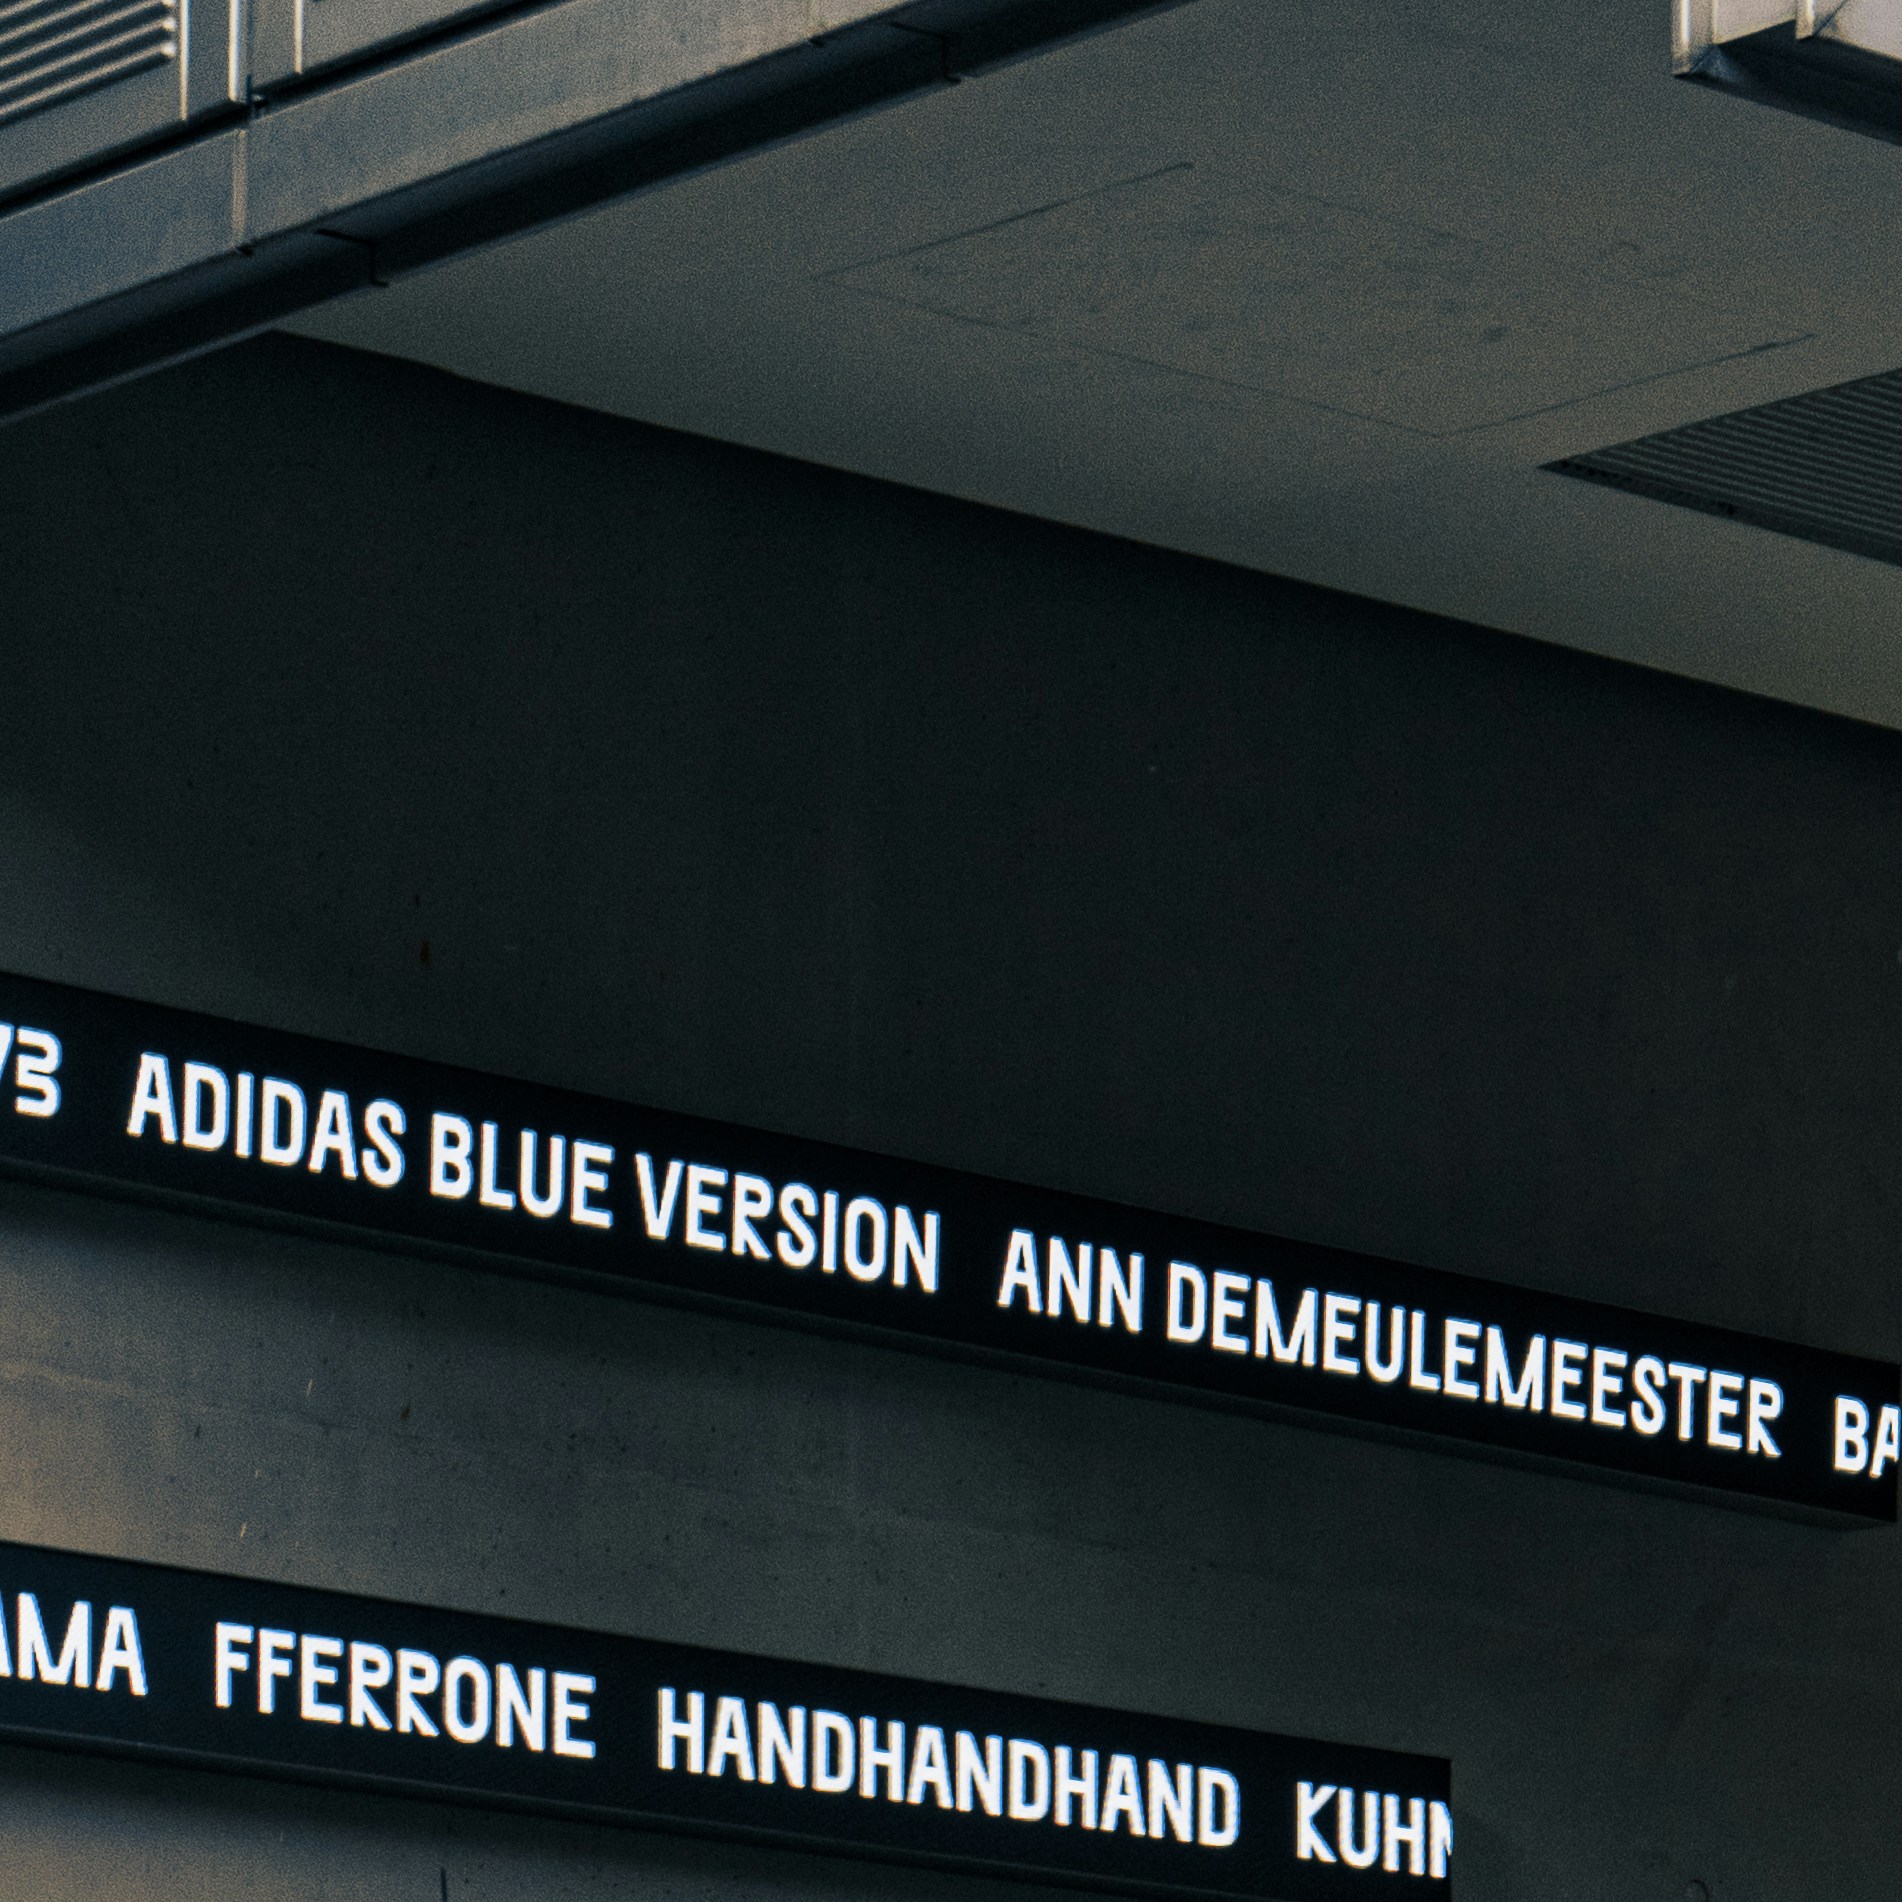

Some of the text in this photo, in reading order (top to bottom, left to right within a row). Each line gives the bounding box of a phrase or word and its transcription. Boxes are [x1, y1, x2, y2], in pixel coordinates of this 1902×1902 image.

[126, 1051, 406, 1188] ADIDAS
[430, 1111, 614, 1229] BLUE
[634, 1152, 939, 1293] VERSION
[997, 1228, 1144, 1334] ANN
[1166, 1261, 1783, 1458] DEMEULEMEESTER
[0, 1588, 148, 1696] MA
[215, 1621, 596, 1759] FFERRONE
[657, 1687, 1240, 1848] HANDHANDHAND
